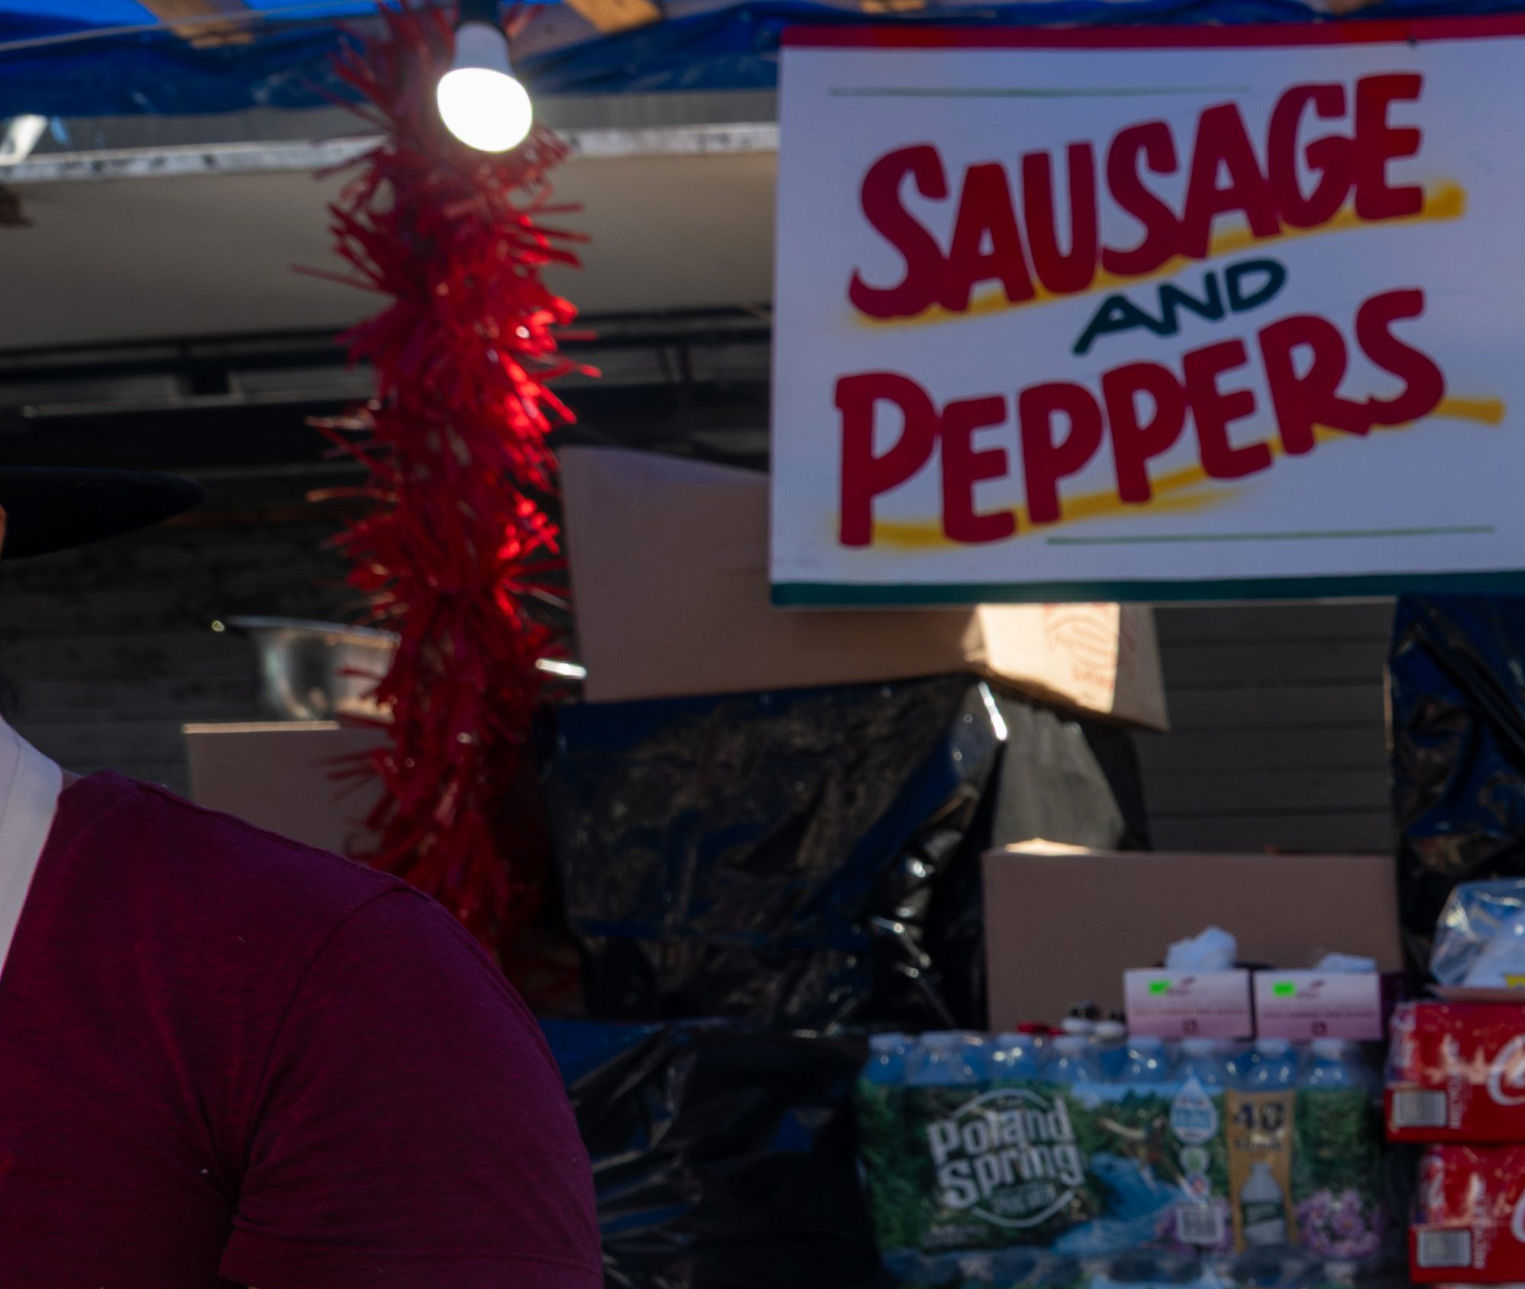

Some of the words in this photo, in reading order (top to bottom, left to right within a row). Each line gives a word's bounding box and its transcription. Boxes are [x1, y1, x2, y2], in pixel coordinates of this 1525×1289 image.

[849, 74, 1423, 317] SAUSAGE
[1072, 257, 1287, 355] AND
[835, 287, 1446, 547] PEPPERS
[926, 1094, 1076, 1165] Poland
[937, 1143, 1085, 1209] Spring
